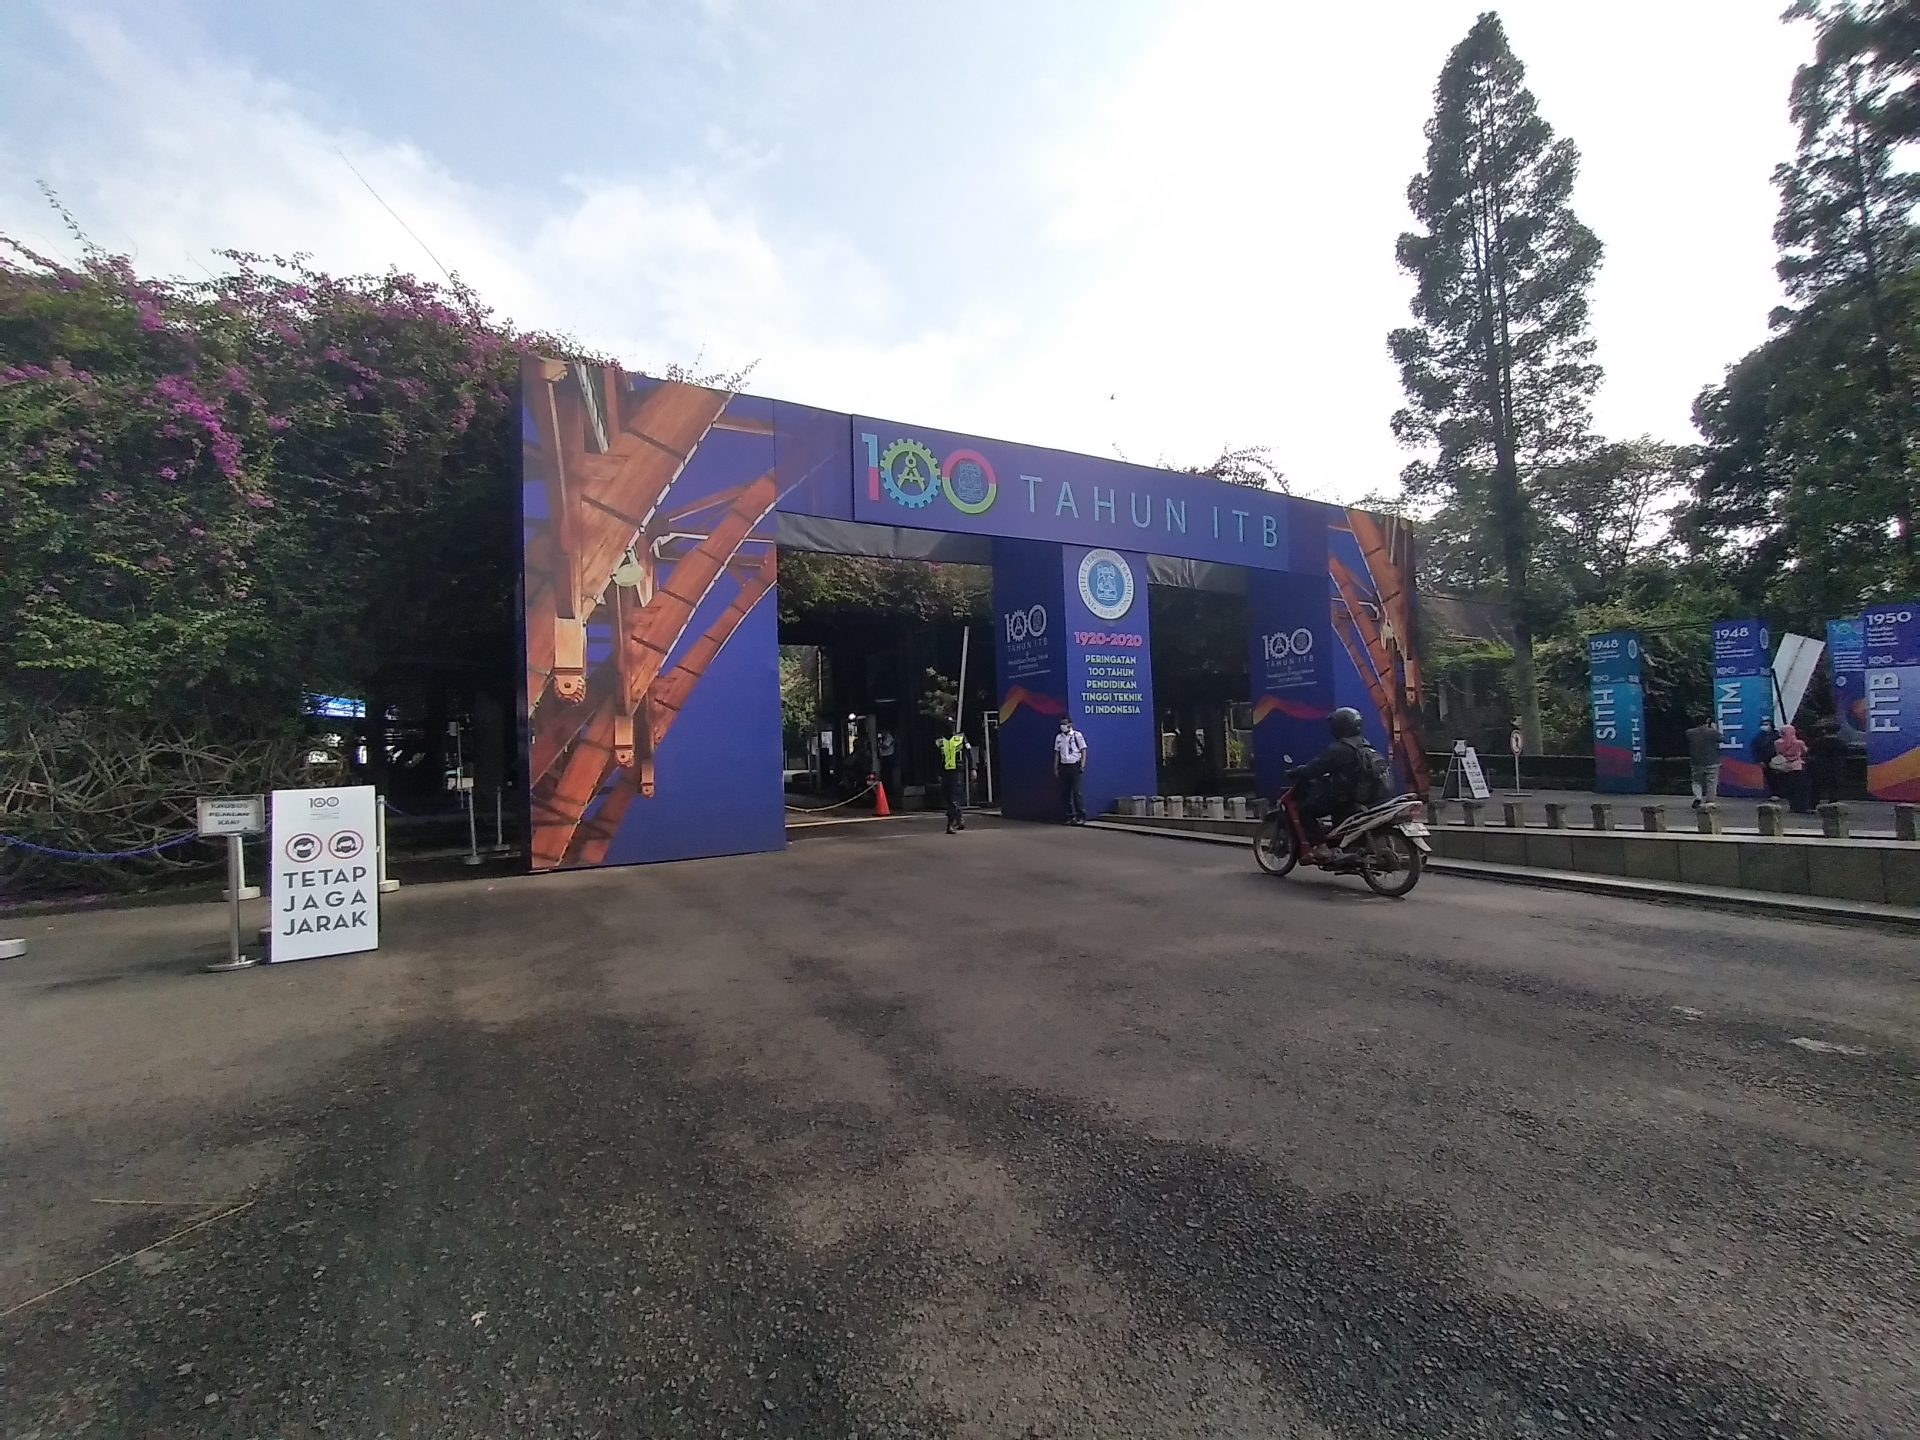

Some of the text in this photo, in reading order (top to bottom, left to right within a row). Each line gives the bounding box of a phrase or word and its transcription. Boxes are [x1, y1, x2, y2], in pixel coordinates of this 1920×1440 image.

[862, 433, 1279, 549] 100 TAHUN ITB
[1004, 604, 1047, 644] 100
[1866, 611, 1912, 626] 1950
[1074, 632, 1143, 647] 1920-2020
[1262, 627, 1313, 660] 100
[1590, 639, 1619, 651] 1948
[1715, 627, 1749, 640] 1948
[1085, 654, 1137, 665] PERINGATAN
[1088, 667, 1135, 677] 100 TAHUN
[1086, 679, 1137, 689] PENDIDIKAN
[1081, 692, 1143, 702] TINGGI TEKNIK
[1869, 672, 1900, 732] FITB
[1084, 705, 1141, 714] DI INDONESIA
[1593, 689, 1616, 739] SITH
[1717, 682, 1744, 749] FTTM
[1631, 718, 1641, 763] SITH
[282, 866, 367, 889] TETAP
[282, 889, 367, 912] JAGA
[282, 910, 368, 936] JARAK
